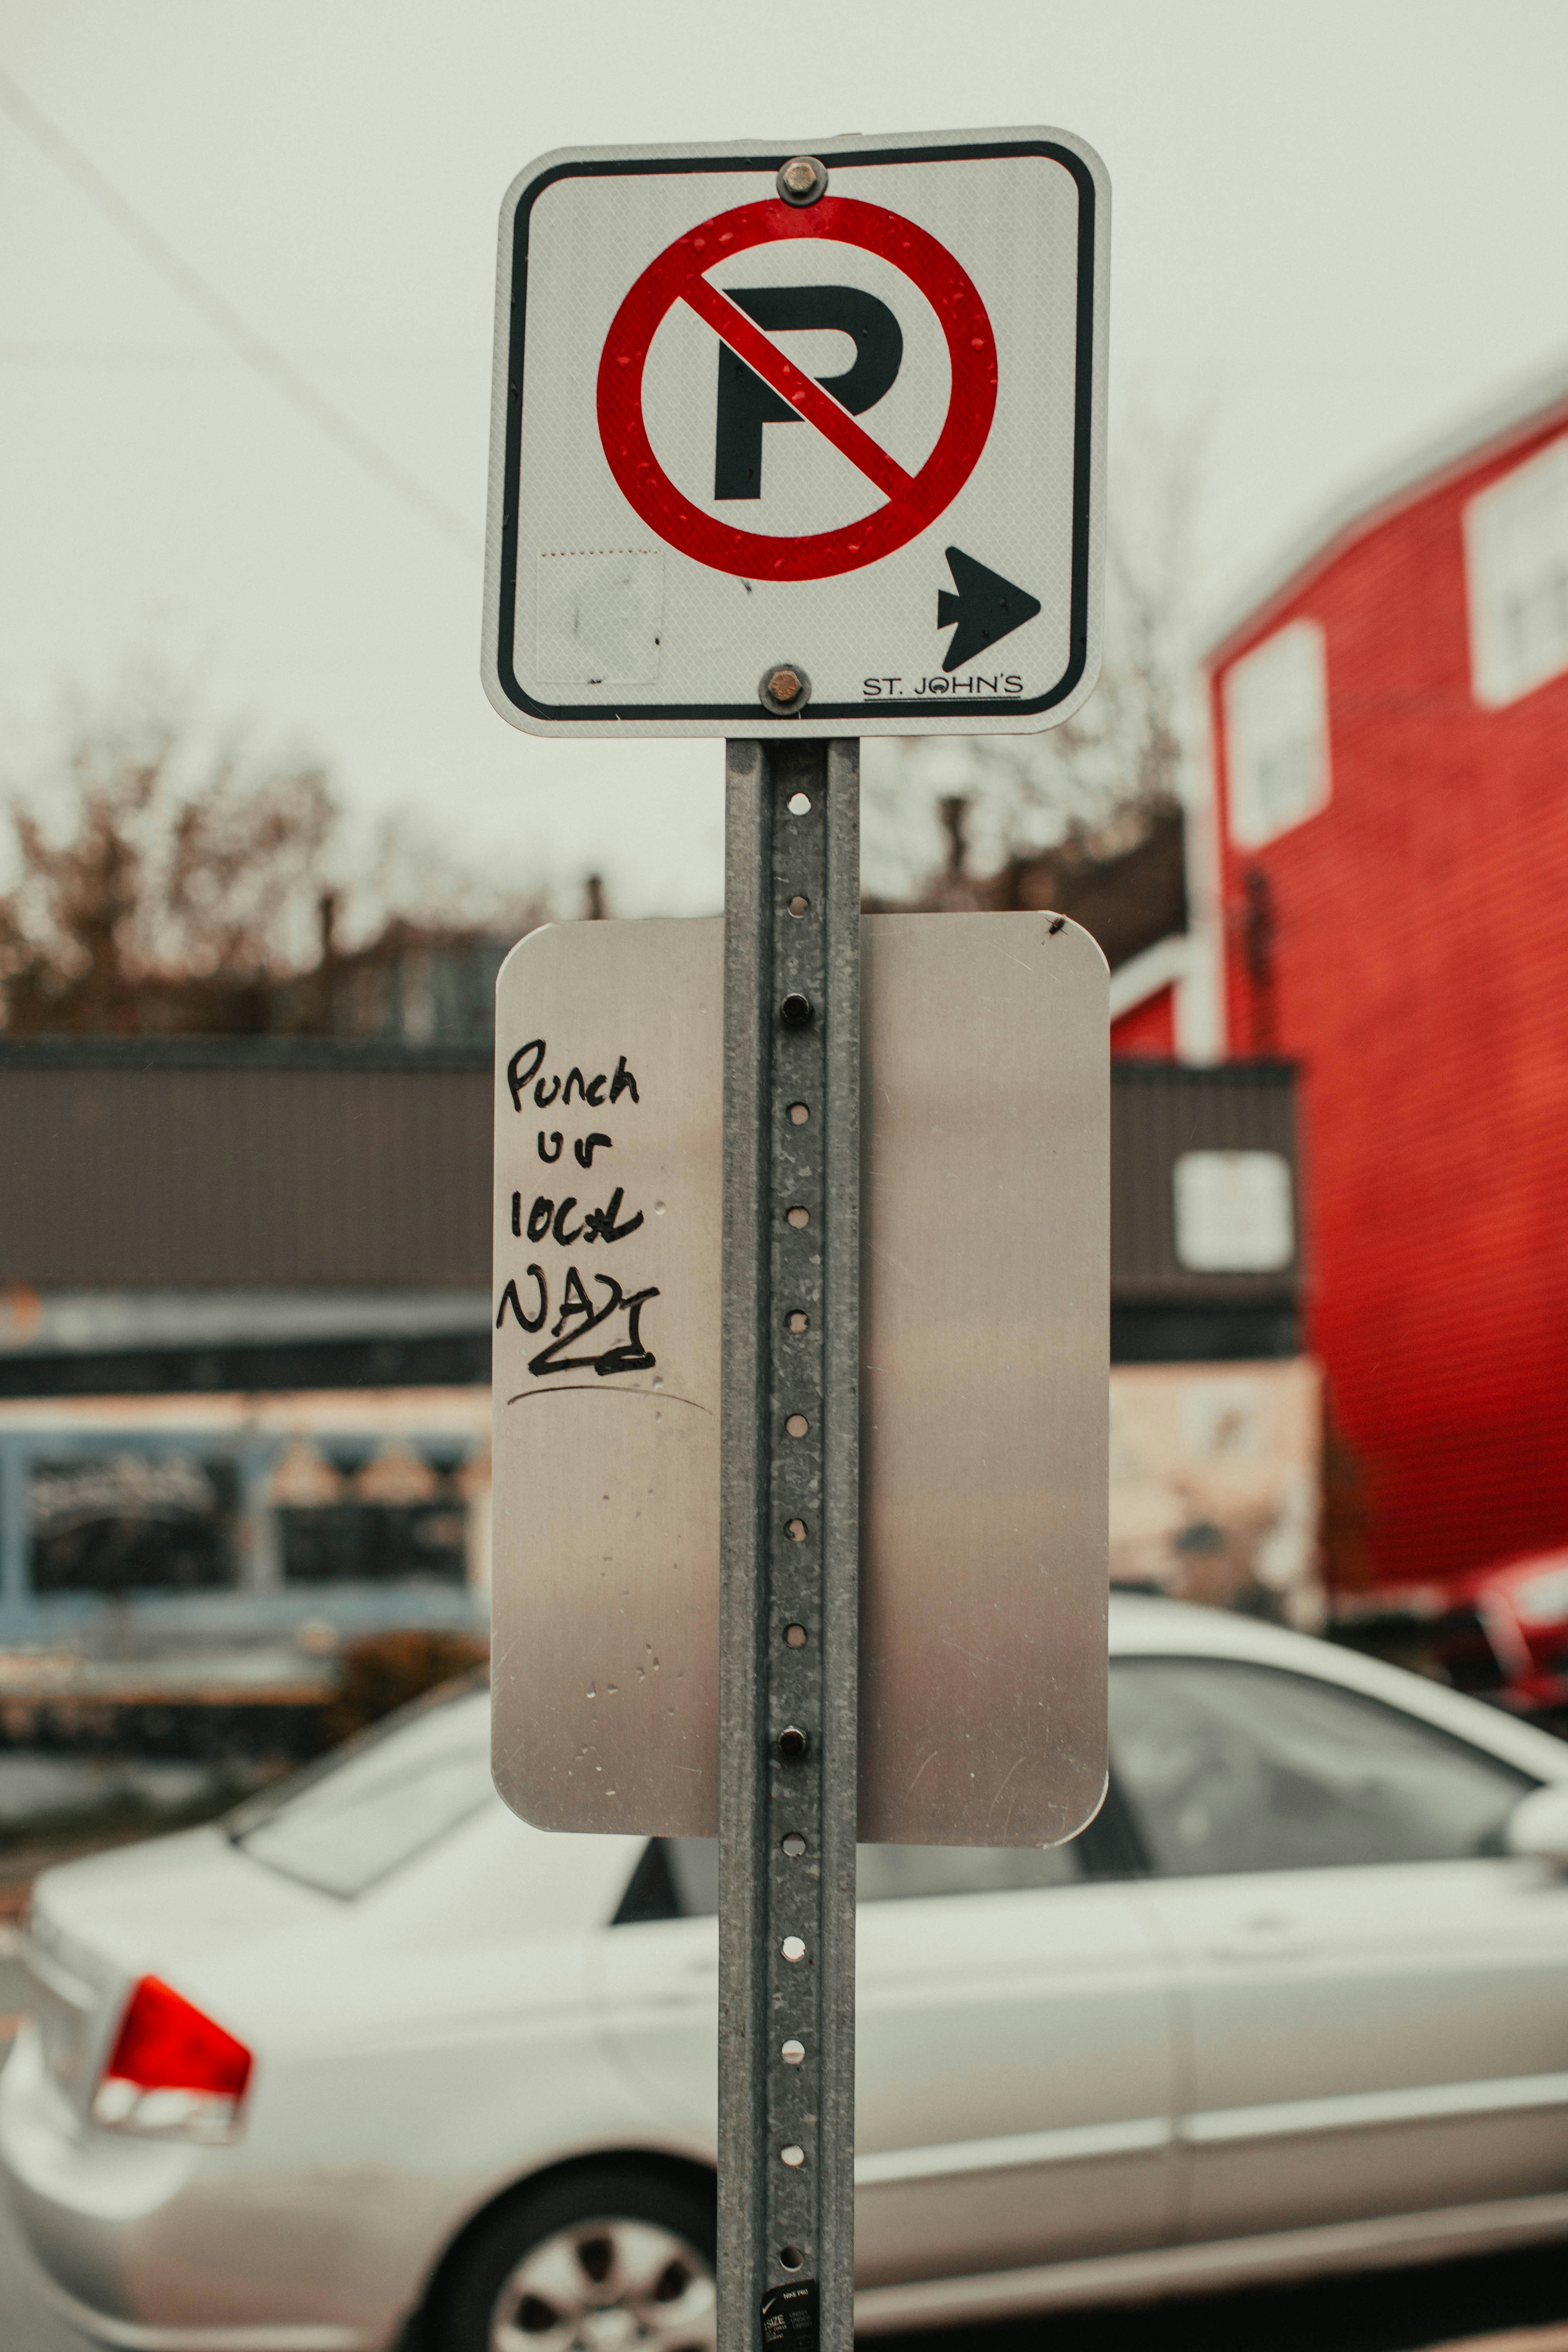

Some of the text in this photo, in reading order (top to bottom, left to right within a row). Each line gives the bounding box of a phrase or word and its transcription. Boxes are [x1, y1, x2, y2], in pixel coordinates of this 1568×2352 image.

[715, 285, 904, 501] P
[863, 673, 1023, 695] ST. JOHN'S
[507, 1039, 639, 1113] Punch
[538, 1131, 613, 1169] ur
[783, 2291, 797, 2299] NIKE
[767, 2314, 786, 2329] SIZE
